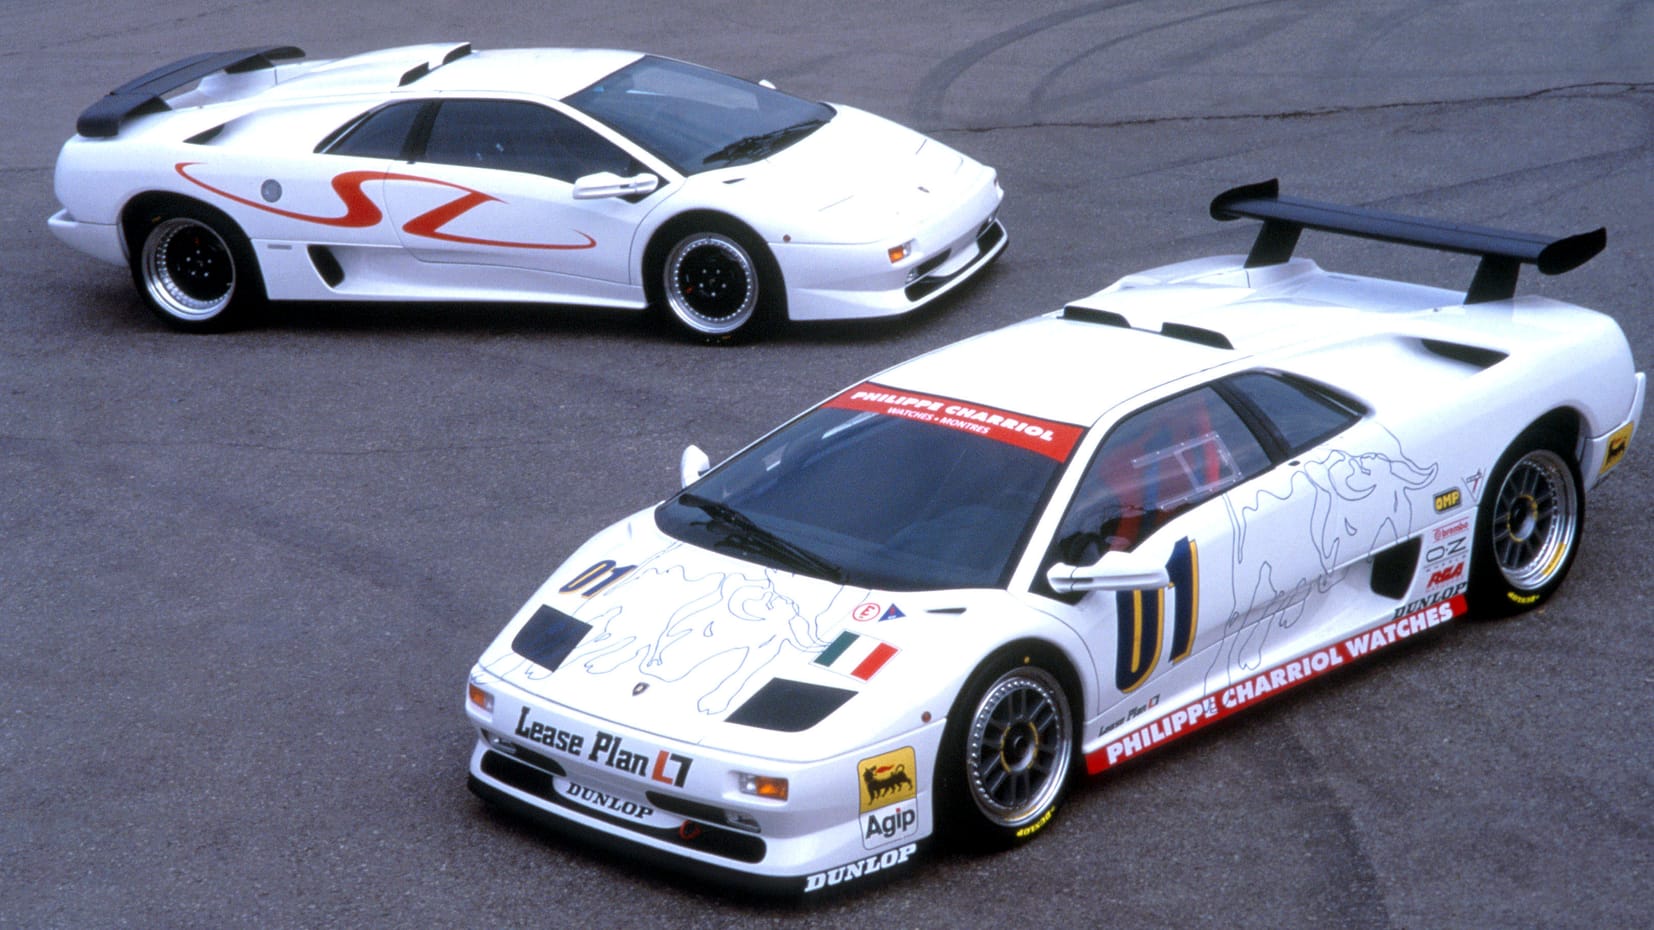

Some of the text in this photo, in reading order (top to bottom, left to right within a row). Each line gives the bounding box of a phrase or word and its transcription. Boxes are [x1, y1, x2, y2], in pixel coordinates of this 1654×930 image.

[850, 391, 1054, 442] PHILIPPE CHARRIOL
[887, 406, 991, 435] WATCHES MONTRES
[1434, 490, 1461, 511] OMP
[557, 560, 638, 600] 01
[1392, 582, 1467, 621] DUNLOP
[1106, 602, 1454, 765] PHILIPPE CHARRIOL WATCHES
[514, 706, 584, 756] Lease
[588, 730, 649, 777] Plan
[566, 782, 654, 819] DUNLOP
[865, 807, 916, 840] Agip
[804, 842, 918, 893] DUNLOP
